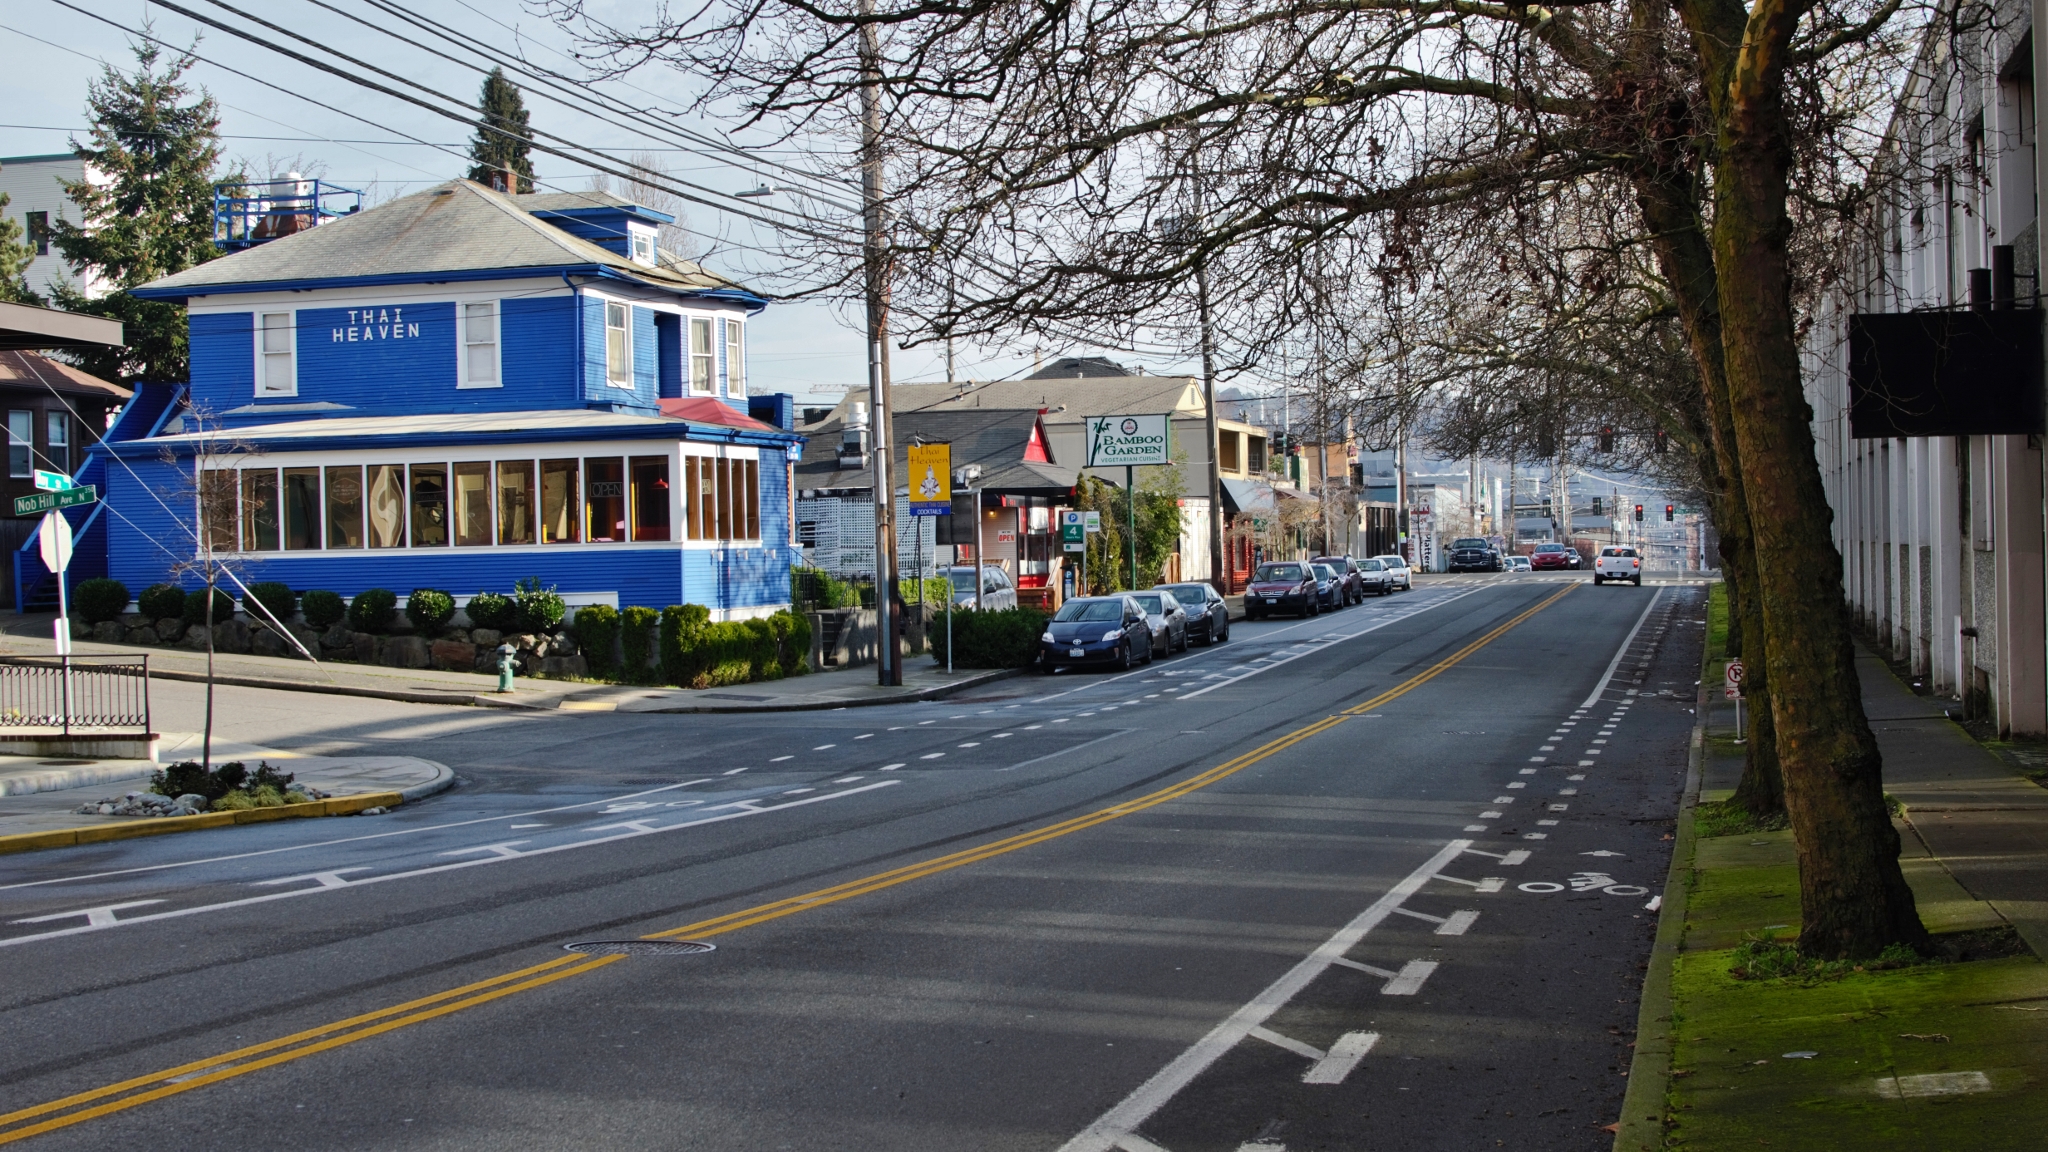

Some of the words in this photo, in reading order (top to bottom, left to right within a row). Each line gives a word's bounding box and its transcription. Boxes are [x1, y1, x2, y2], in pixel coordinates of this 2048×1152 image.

[347, 308, 402, 325] THAI
[333, 323, 419, 343] HEAVEN
[1103, 435, 1163, 446] BAMBOO
[1104, 446, 1162, 456] GARDEN
[910, 456, 949, 465] Heaven
[592, 483, 622, 496] OPEN
[17, 499, 37, 513] Nob
[39, 495, 55, 509] Hill
[61, 495, 73, 505] Ave
[79, 493, 85, 502] N
[1069, 526, 1077, 535] 4
